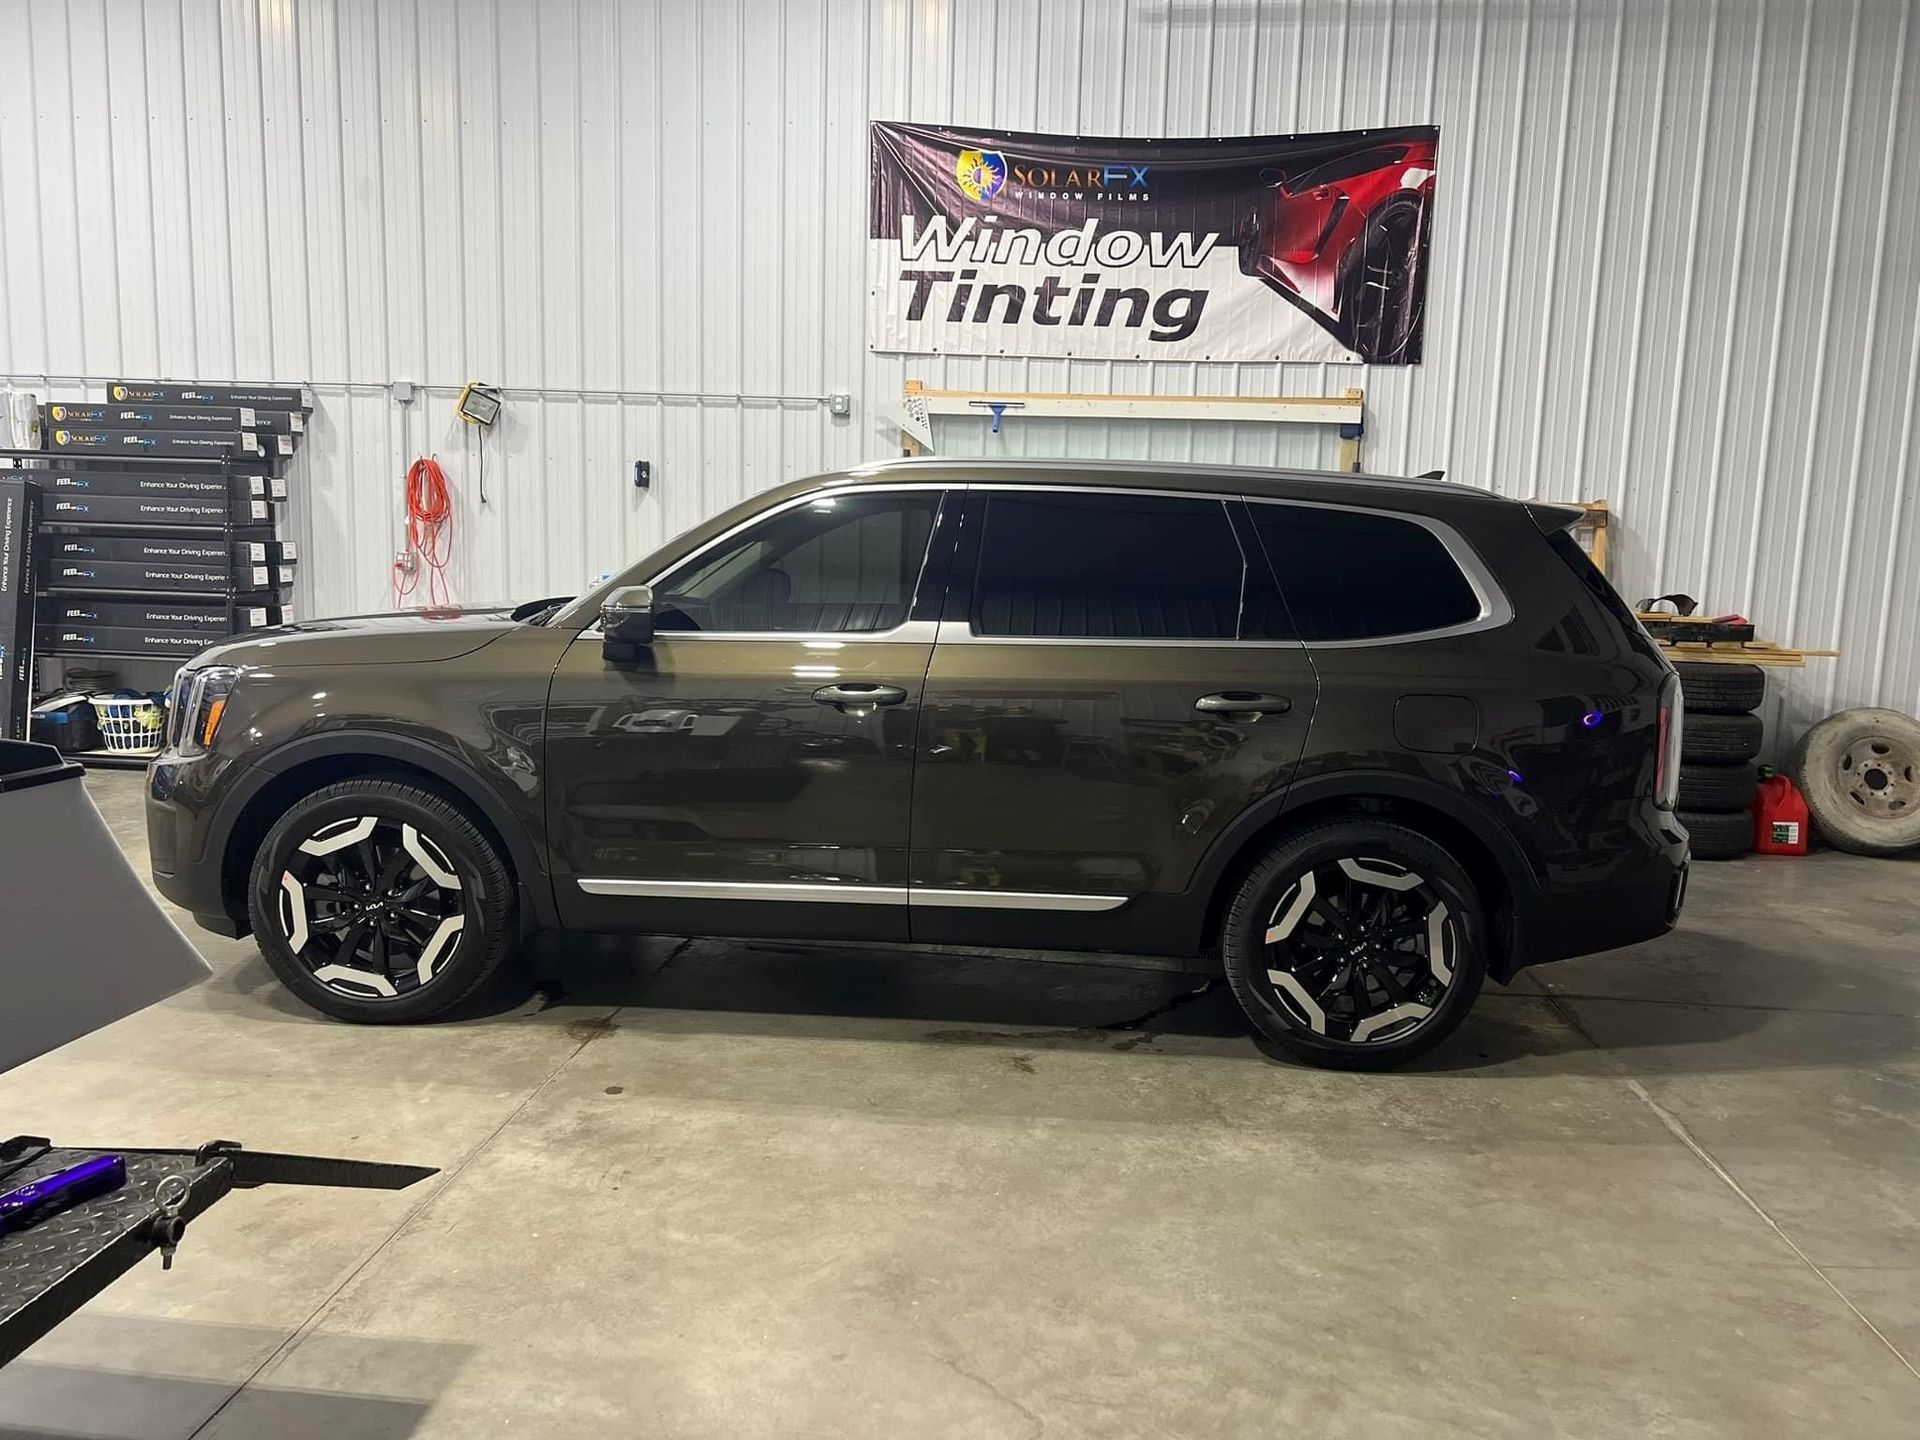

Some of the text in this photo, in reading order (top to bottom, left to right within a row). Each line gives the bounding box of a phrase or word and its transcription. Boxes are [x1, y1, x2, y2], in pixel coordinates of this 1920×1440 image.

[1013, 163, 1149, 188] SOLARFX
[1014, 191, 1149, 201] WINDOW FILMS
[900, 213, 1220, 269] Window
[899, 269, 1209, 342] Tinting
[5, 497, 13, 530] Experience
[4, 530, 12, 552] Driving
[181, 549, 201, 557] Driving
[184, 573, 204, 581] Driving
[184, 615, 204, 623] Driving
